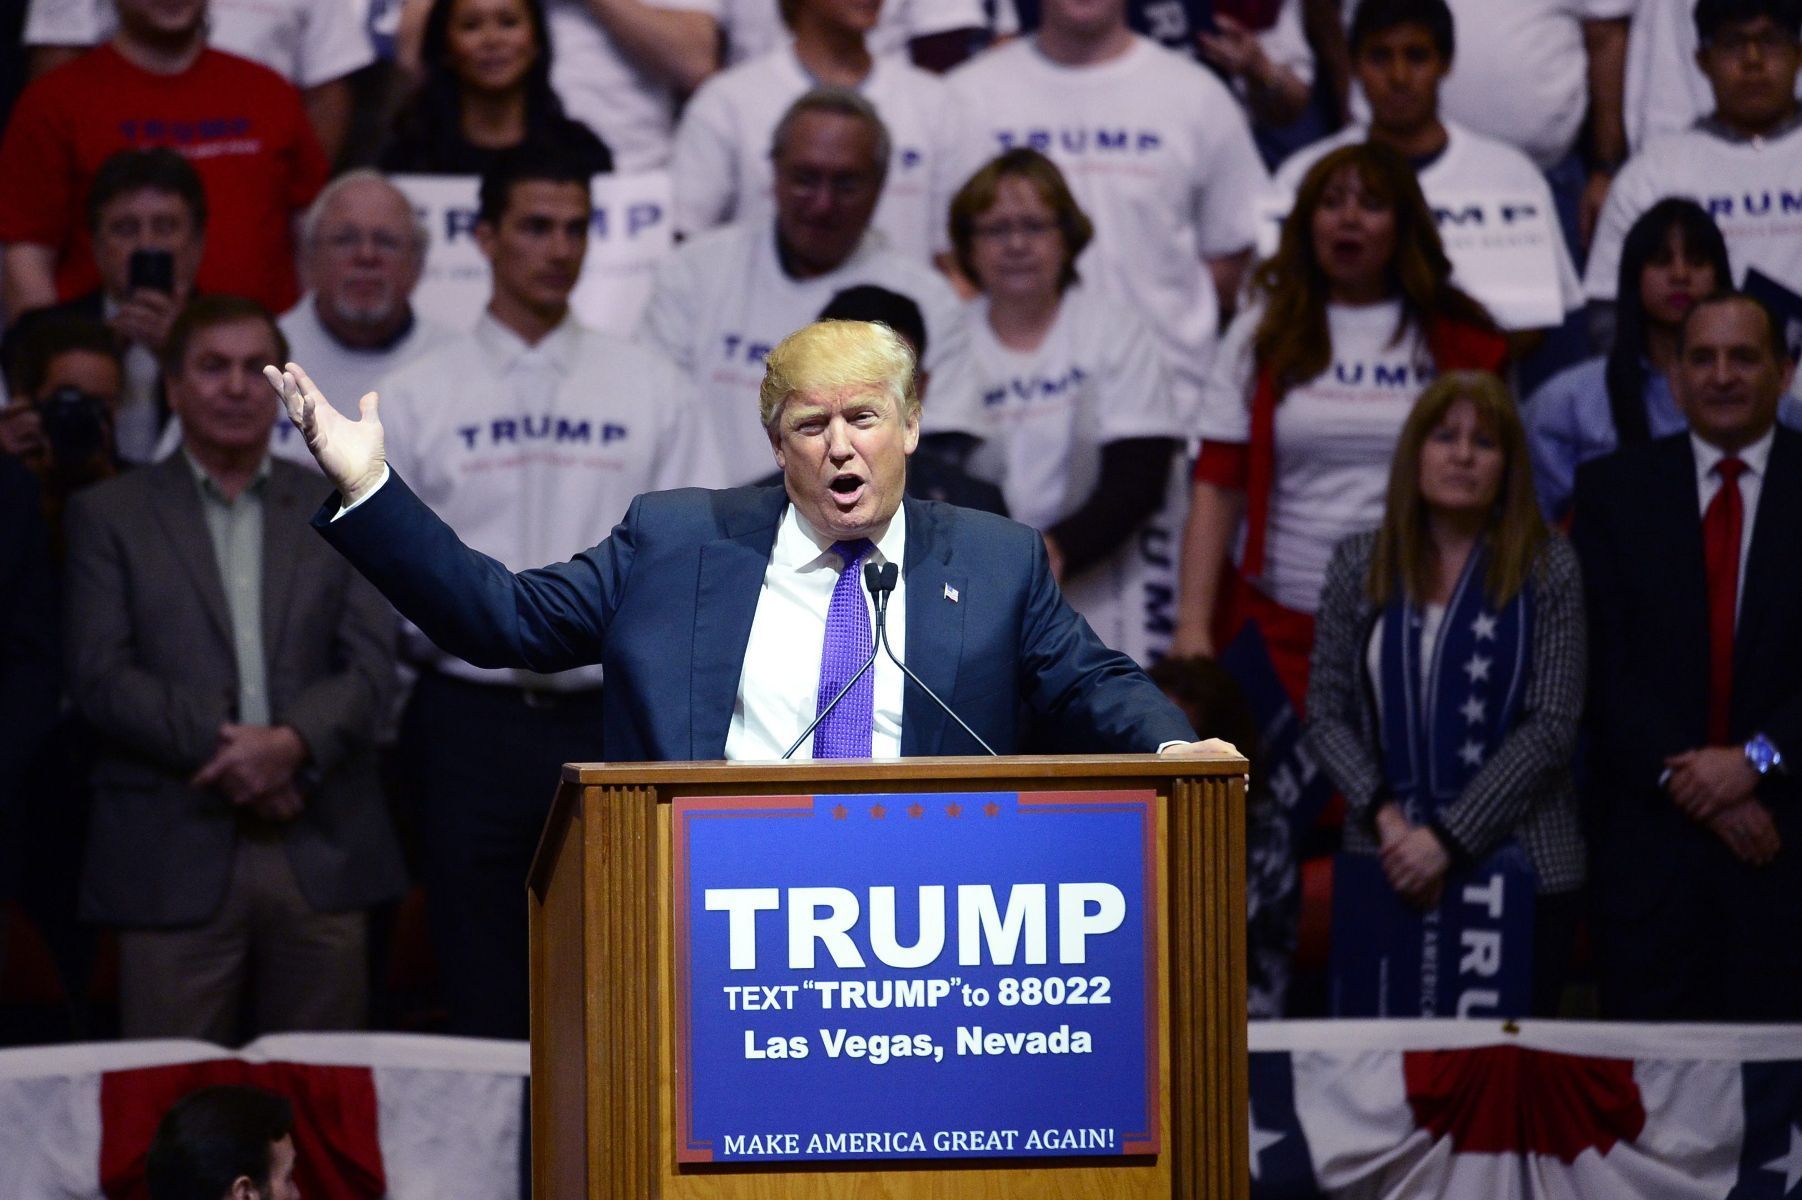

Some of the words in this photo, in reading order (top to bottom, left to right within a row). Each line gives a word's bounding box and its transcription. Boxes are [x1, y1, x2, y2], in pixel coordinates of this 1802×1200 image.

[457, 415, 627, 450] TRUMP
[705, 882, 1126, 970] TRUMP
[724, 986, 799, 1011] TEXT
[962, 983, 990, 1007] to
[998, 976, 1111, 1006] 88022
[745, 1030, 809, 1059] Las
[820, 1028, 944, 1065] Vegas,
[957, 1025, 1092, 1056] Nevada
[724, 1134, 800, 1155] MAKE
[805, 1132, 927, 1154] AMERICA
[933, 1130, 1019, 1152] GREAT
[1025, 1128, 1115, 1150] AGAIN!
